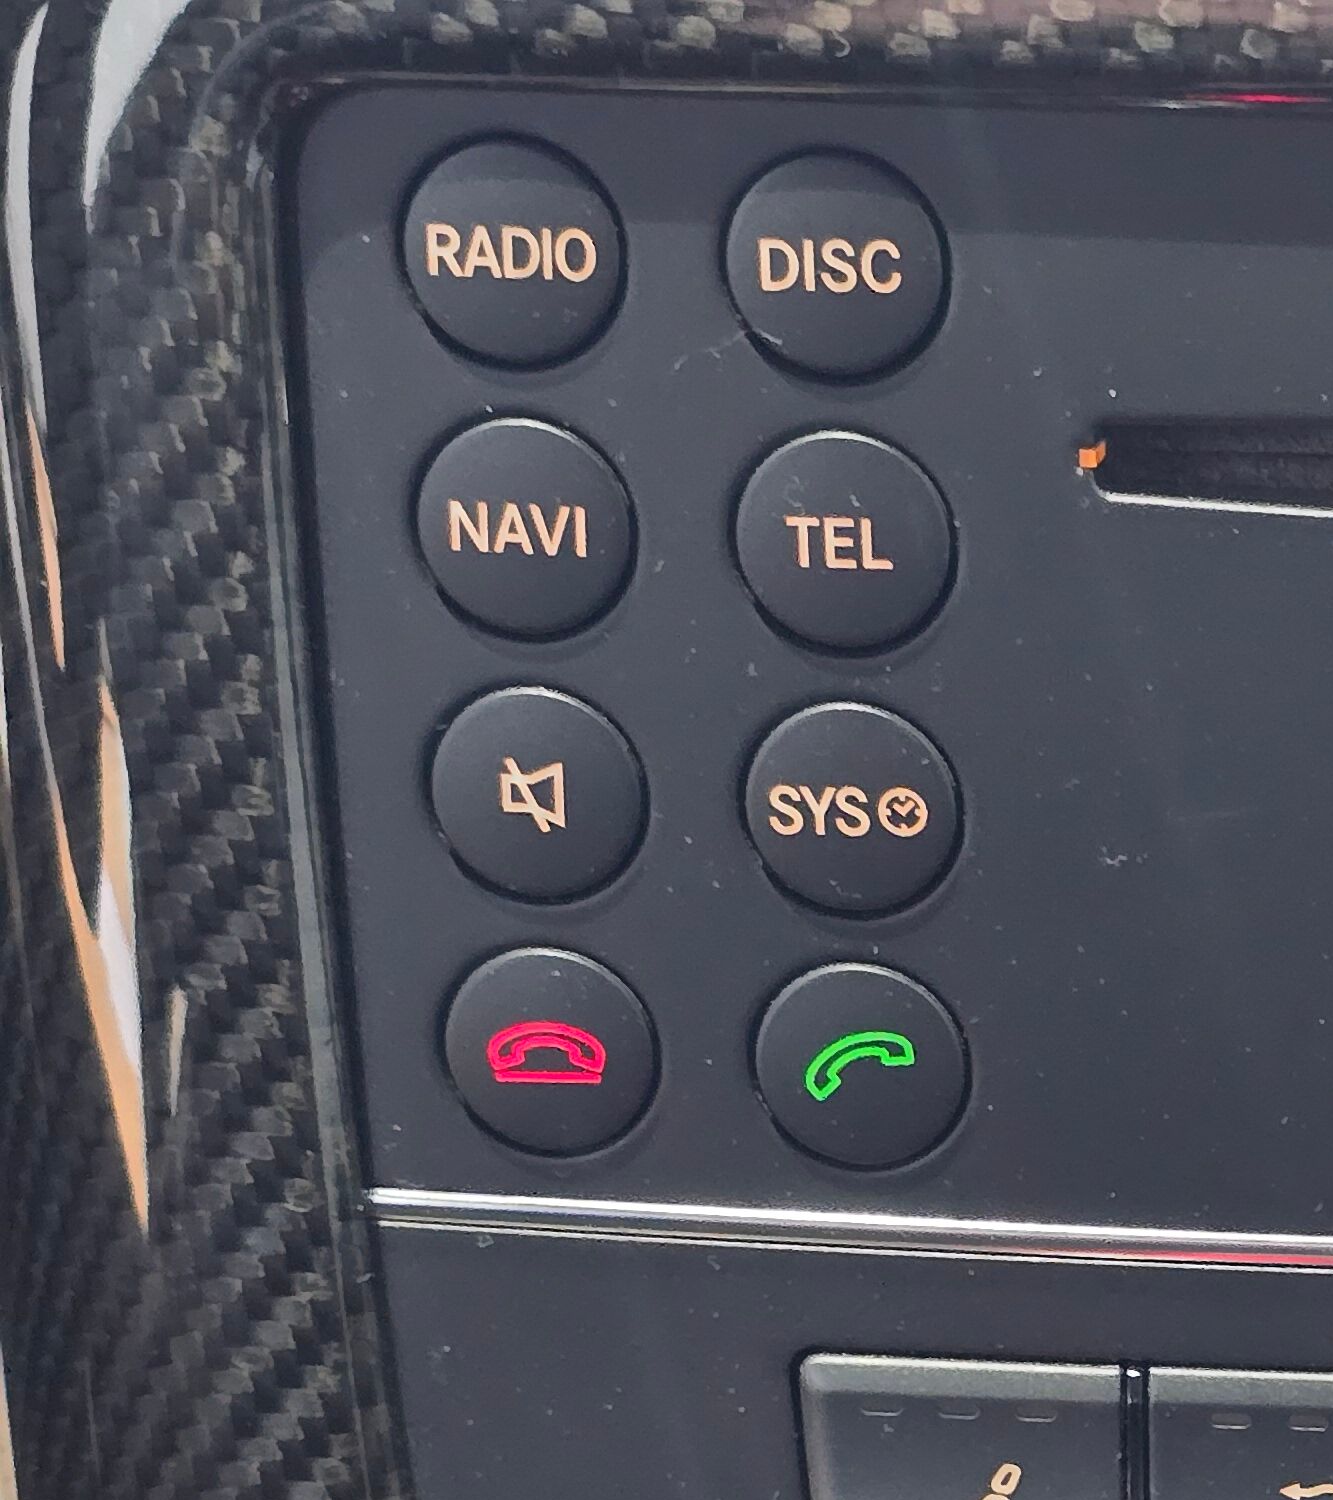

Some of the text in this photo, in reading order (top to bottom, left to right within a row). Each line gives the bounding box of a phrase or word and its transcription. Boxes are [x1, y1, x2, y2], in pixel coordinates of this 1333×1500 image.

[425, 223, 597, 283] RADIO
[757, 237, 902, 294] DISC
[448, 499, 587, 558] NAVI
[784, 515, 894, 570] TEL
[768, 784, 871, 837] SYS
